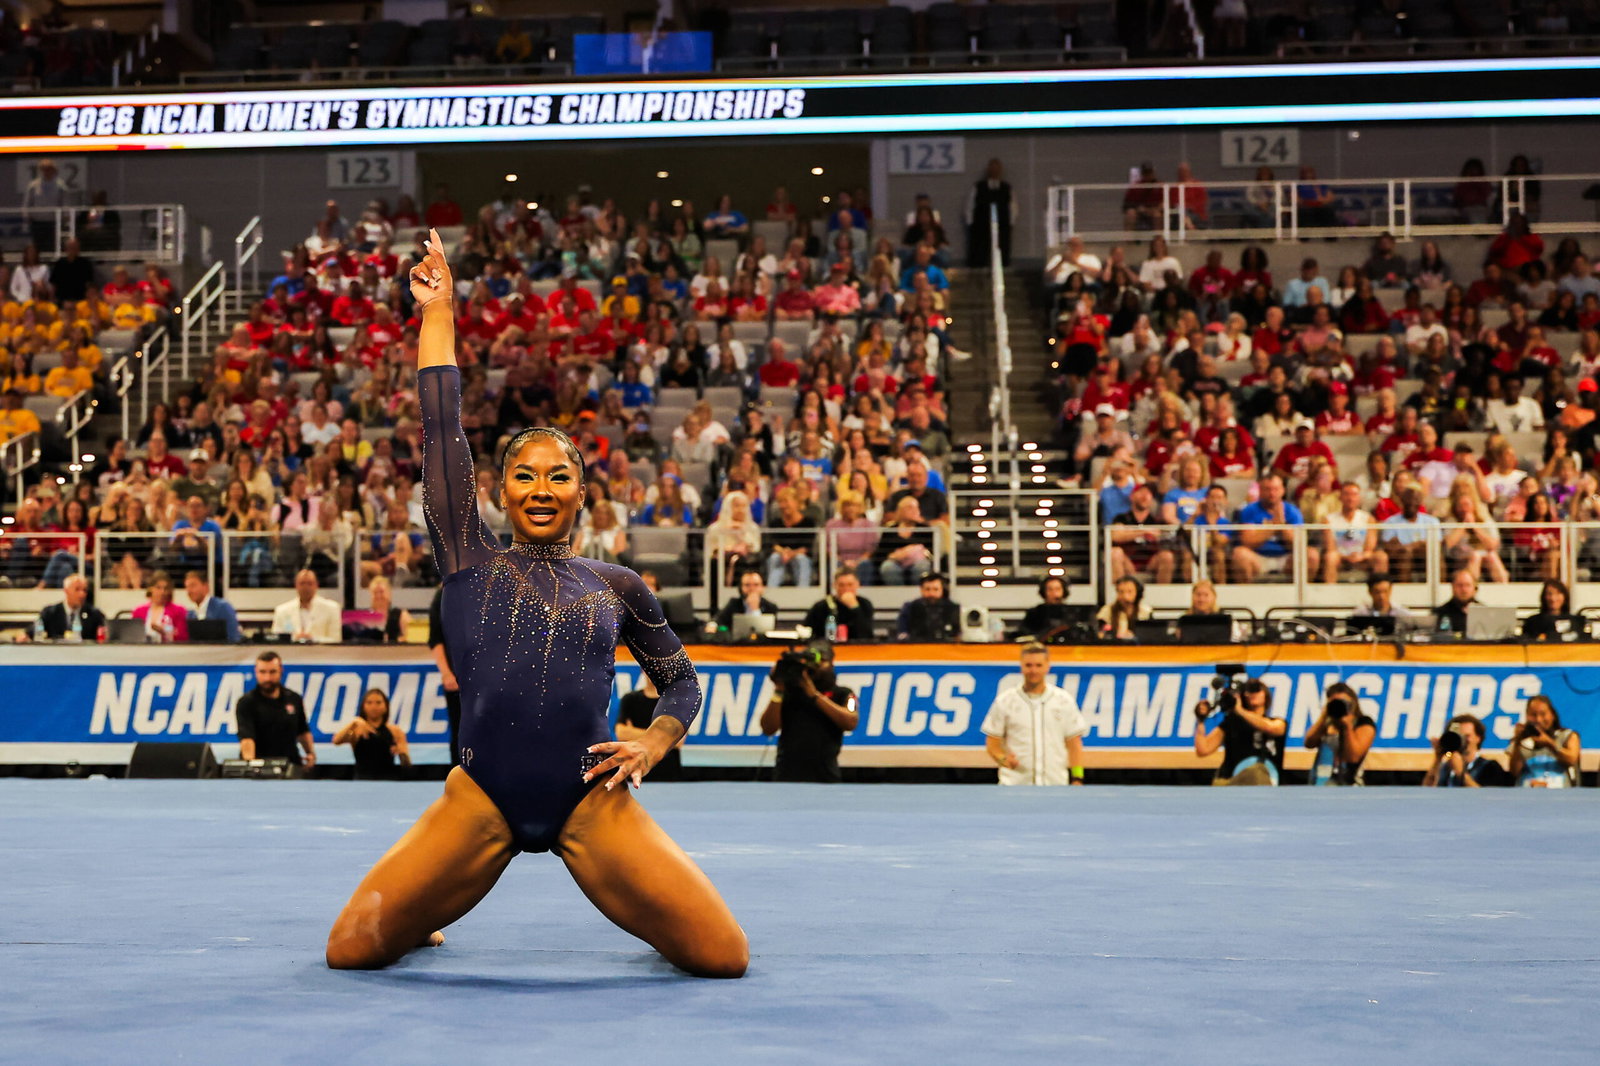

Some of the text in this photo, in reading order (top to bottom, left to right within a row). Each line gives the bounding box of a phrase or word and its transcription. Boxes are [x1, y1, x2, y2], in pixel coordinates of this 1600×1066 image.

[57, 86, 806, 137] 2026 NCAA WOMEN'S GYMNASTICS CHAMPIONSHIPS
[901, 143, 955, 170] 123
[1233, 137, 1289, 162] 124
[337, 158, 390, 184] 123
